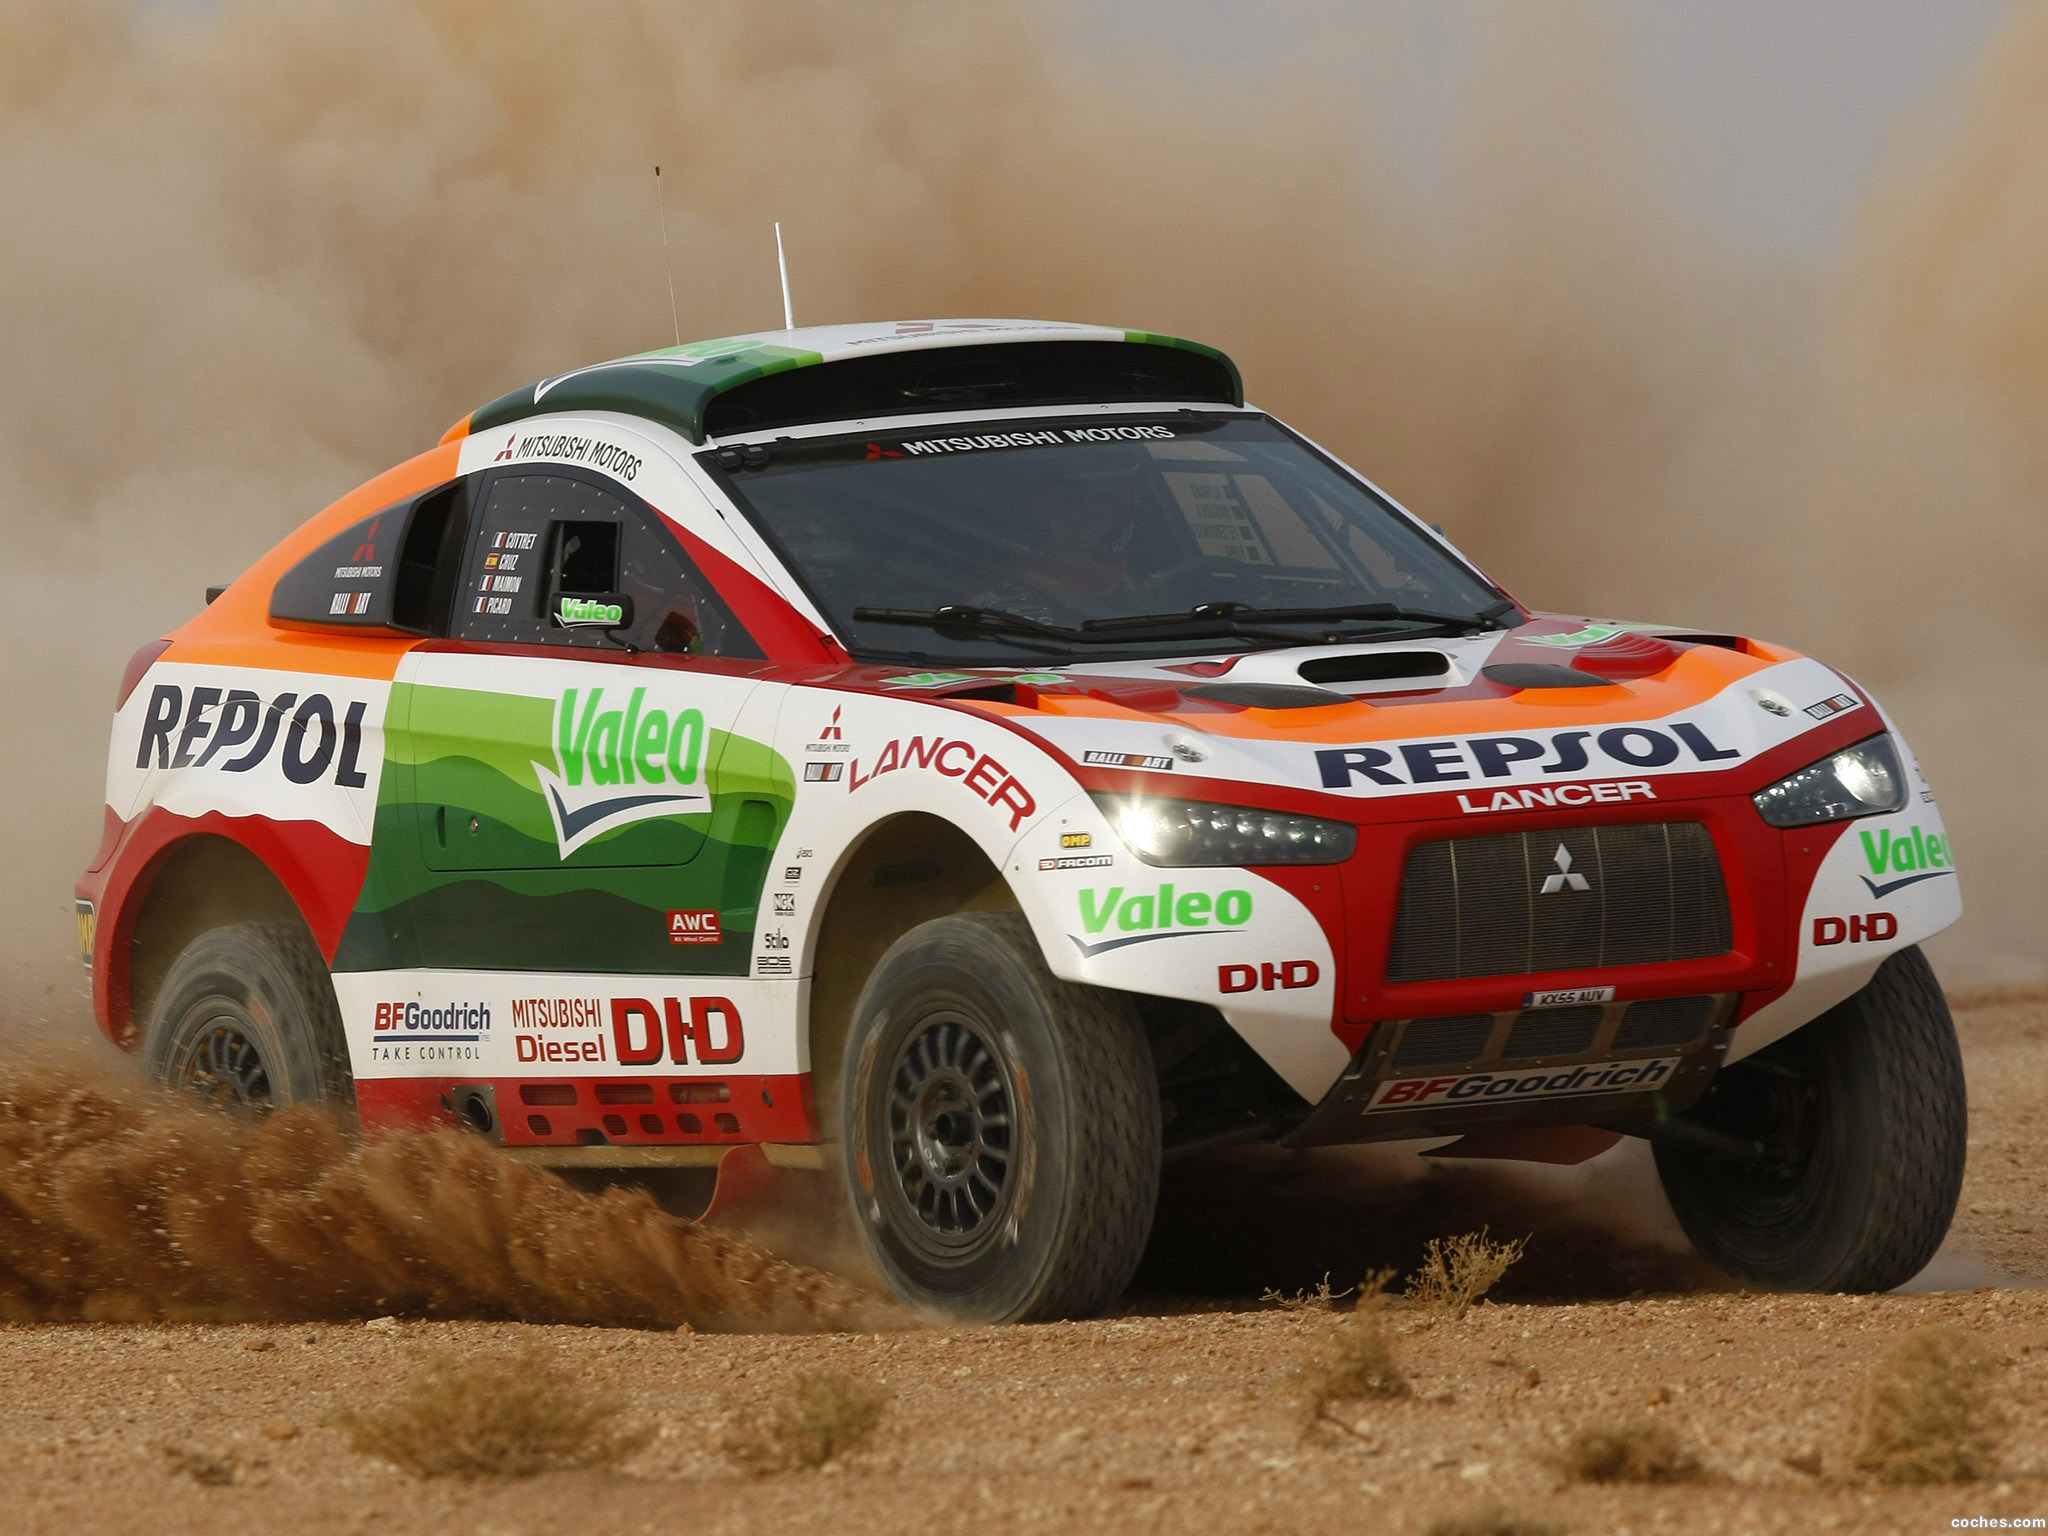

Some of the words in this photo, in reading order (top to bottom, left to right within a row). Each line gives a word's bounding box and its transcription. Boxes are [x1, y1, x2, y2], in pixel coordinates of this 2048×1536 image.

[901, 430, 1065, 455] MITSUBISHI
[1064, 425, 1176, 443] MOTORS
[516, 435, 592, 460] MITSUBISHI
[587, 441, 643, 481] MOTORS
[505, 533, 538, 550] COTTRET
[334, 566, 362, 578] MITSUBISHI
[498, 554, 519, 571] CRUZ
[491, 576, 522, 593] MAIMON
[486, 598, 512, 614] PICARD
[561, 597, 623, 622] Valeo
[136, 684, 367, 789] REPSOL
[559, 686, 704, 786] Valeo
[1314, 722, 1741, 789] REPSOL
[849, 735, 1036, 833] LANCER
[1456, 781, 1658, 814] LANCER
[1062, 835, 1090, 848] OMP
[1058, 856, 1111, 868] FACOM
[774, 894, 795, 910] NGK
[1078, 883, 1253, 934] Valeo
[672, 914, 716, 930] AWC
[765, 927, 789, 949] Stilo
[1540, 992, 1576, 1005] KX55
[1578, 989, 1606, 1002] AUV
[374, 1002, 491, 1030] BFGoodrich
[511, 998, 602, 1029] MITSUBISHI
[372, 1047, 411, 1060] TAKE
[419, 1046, 481, 1060] CONTROL
[515, 1034, 607, 1063] Diesel
[1377, 1060, 1672, 1106] BFGoodrich
